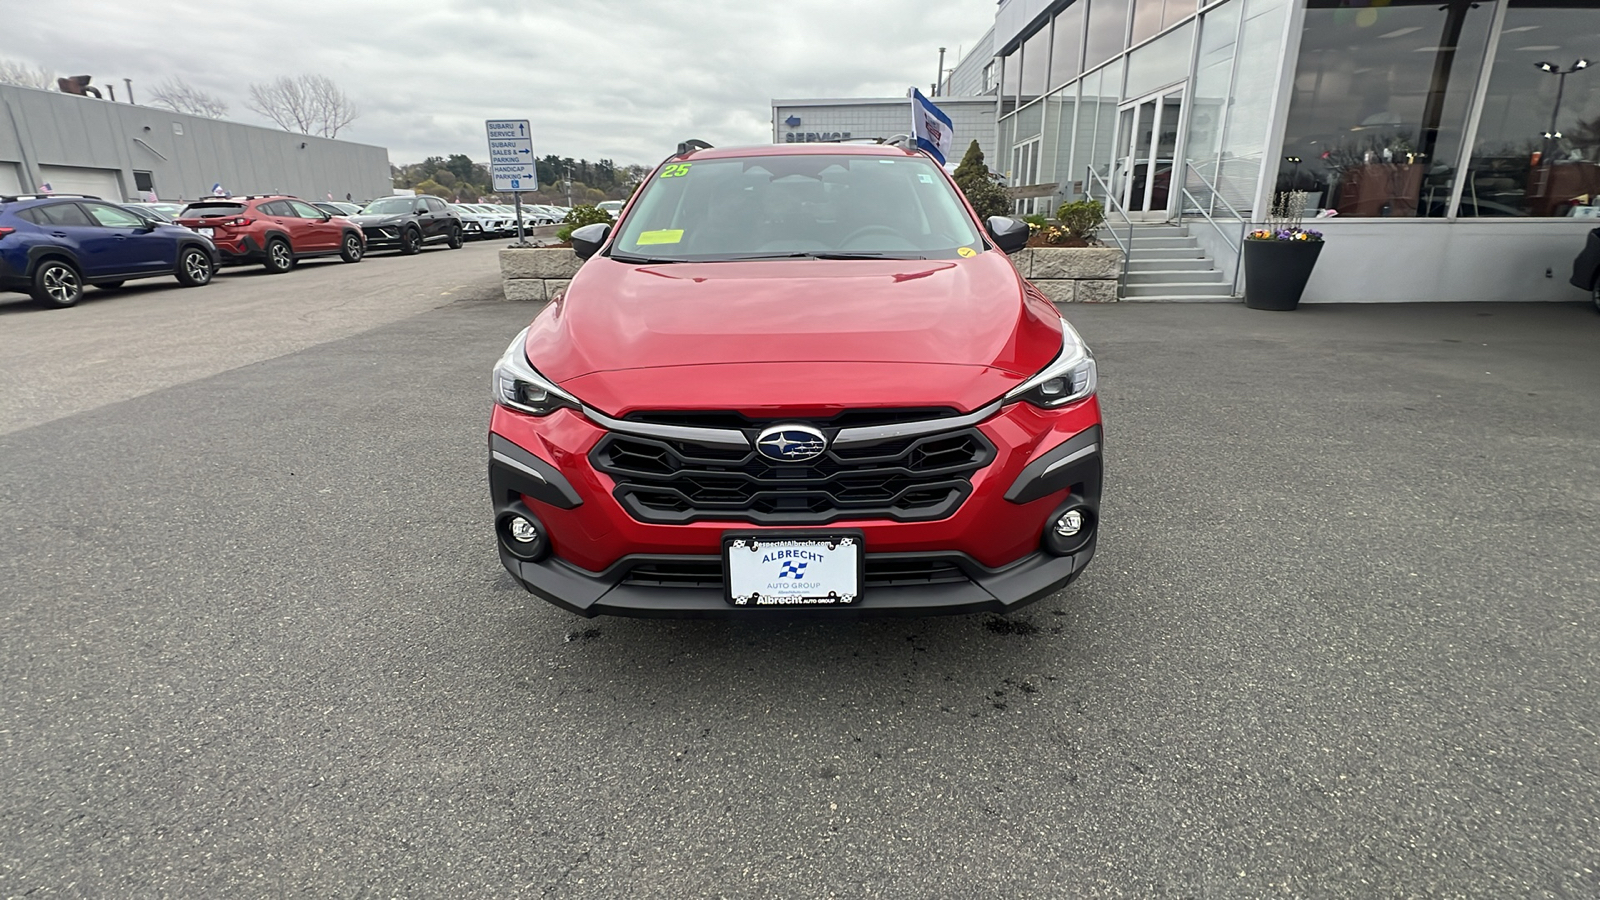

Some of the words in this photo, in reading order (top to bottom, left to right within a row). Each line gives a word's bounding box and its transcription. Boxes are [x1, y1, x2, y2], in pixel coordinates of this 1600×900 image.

[786, 132, 851, 143] SERVICE
[660, 163, 692, 178] 25
[762, 549, 824, 564] ALBRECHT
[756, 594, 803, 605] Albrecht
